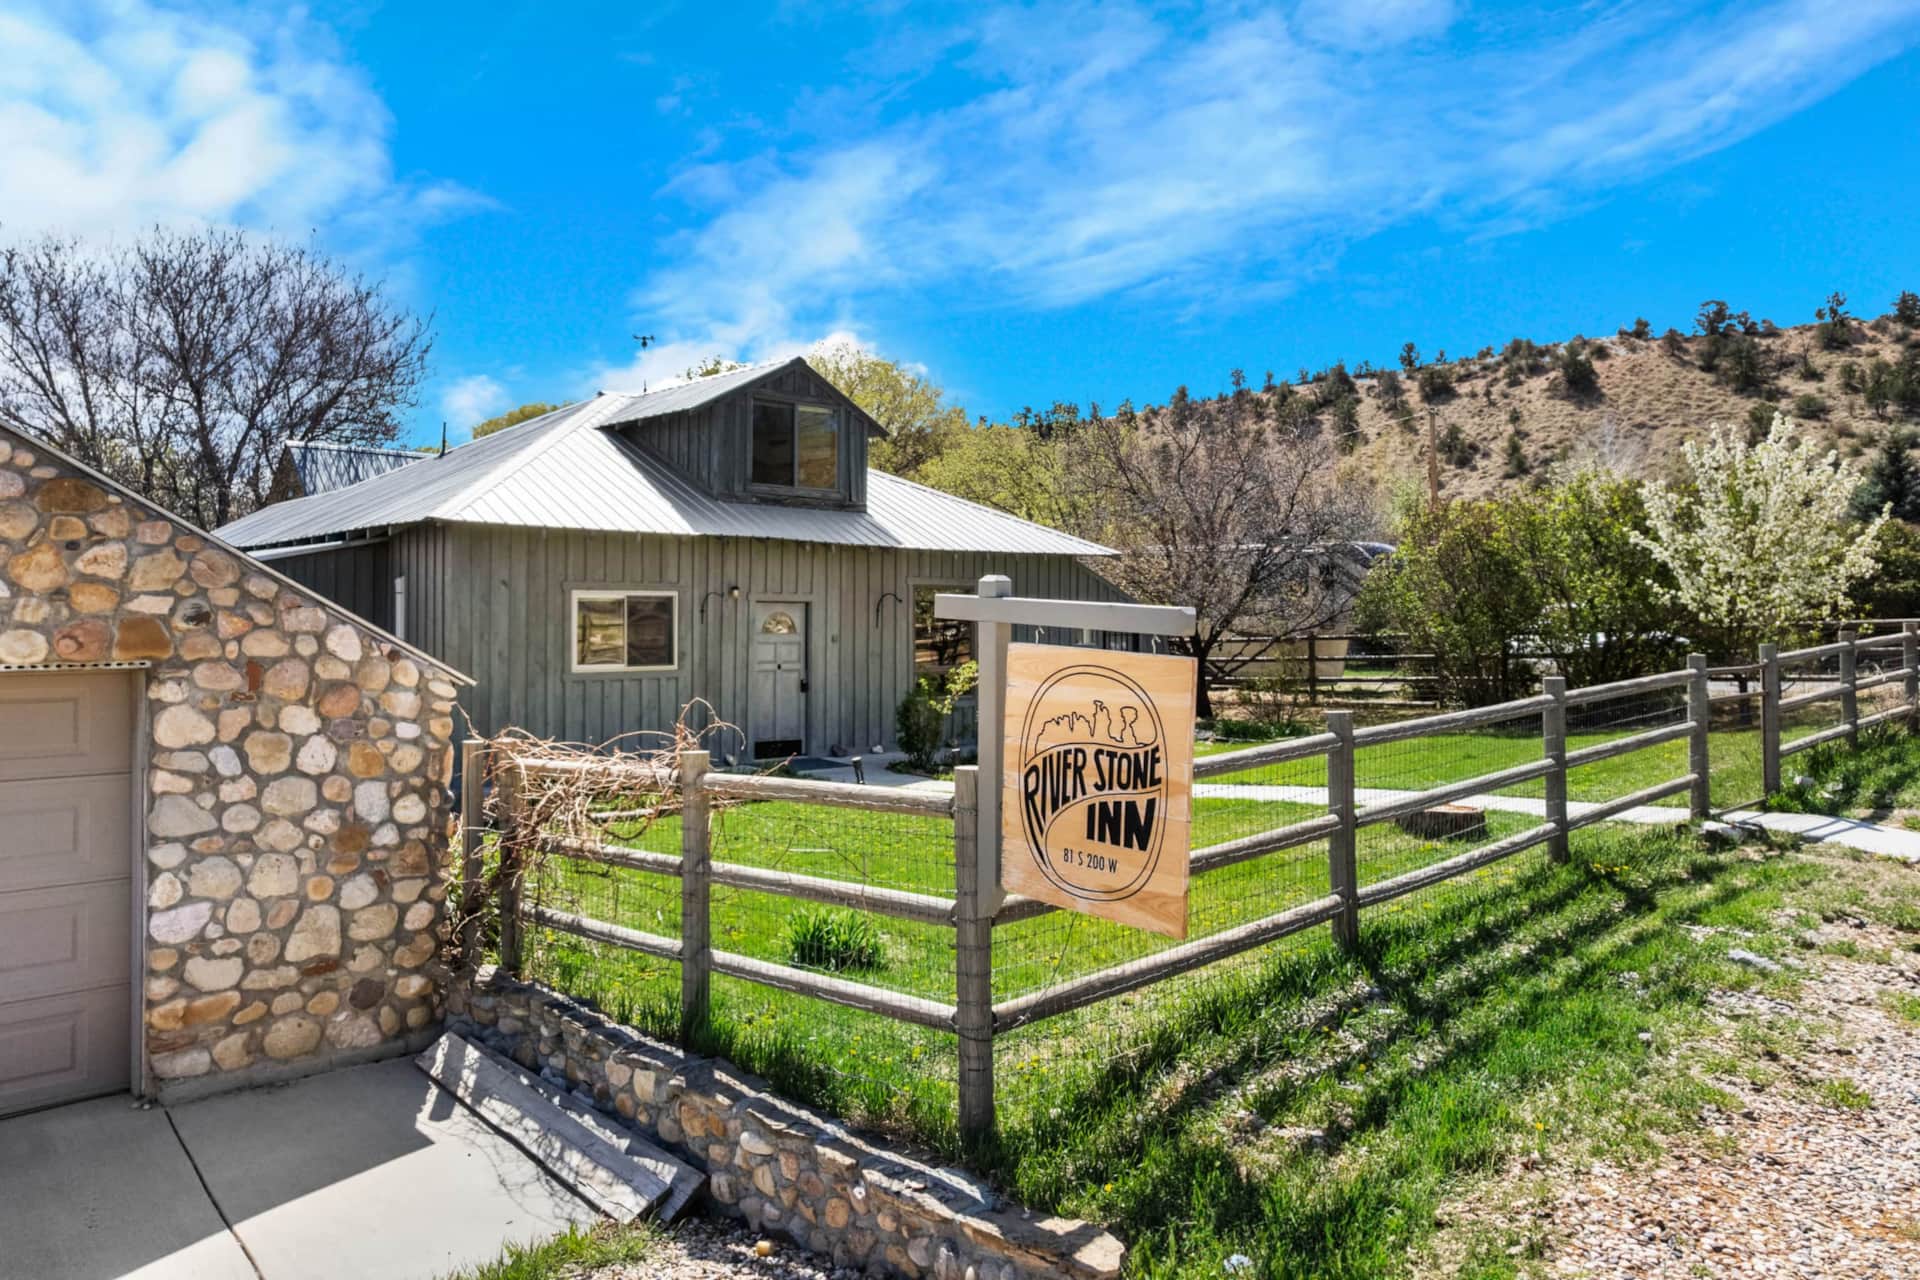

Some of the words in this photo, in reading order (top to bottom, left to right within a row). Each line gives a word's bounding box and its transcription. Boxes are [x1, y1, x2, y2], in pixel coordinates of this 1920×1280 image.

[1024, 748, 1087, 868] RIVER
[1094, 746, 1161, 791] STONE
[1087, 798, 1156, 851] INN
[1063, 848, 1073, 863] 81
[1078, 850, 1083, 866] S
[1087, 853, 1105, 871] 200
[1108, 858, 1118, 873] W
